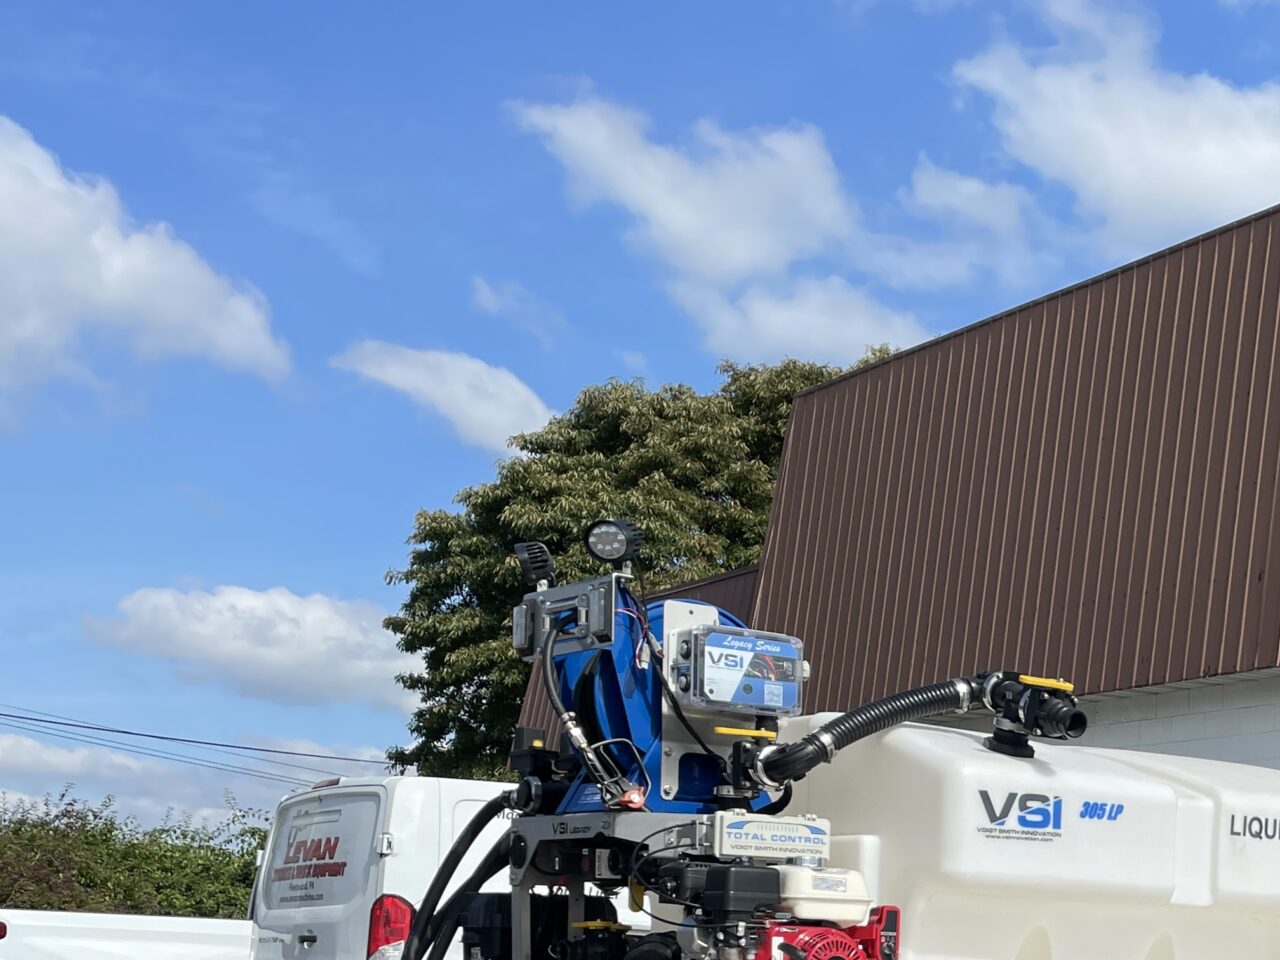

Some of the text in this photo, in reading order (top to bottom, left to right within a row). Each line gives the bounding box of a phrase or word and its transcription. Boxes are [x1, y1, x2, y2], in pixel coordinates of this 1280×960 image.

[722, 636, 781, 652] Legacy Series
[708, 651, 744, 669] VSI
[978, 790, 1063, 830] VSI
[1079, 802, 1125, 821] 305 LP
[552, 822, 569, 834] VSI
[726, 831, 827, 846] TOTAL CONTROL
[284, 836, 340, 864] LEVAN
